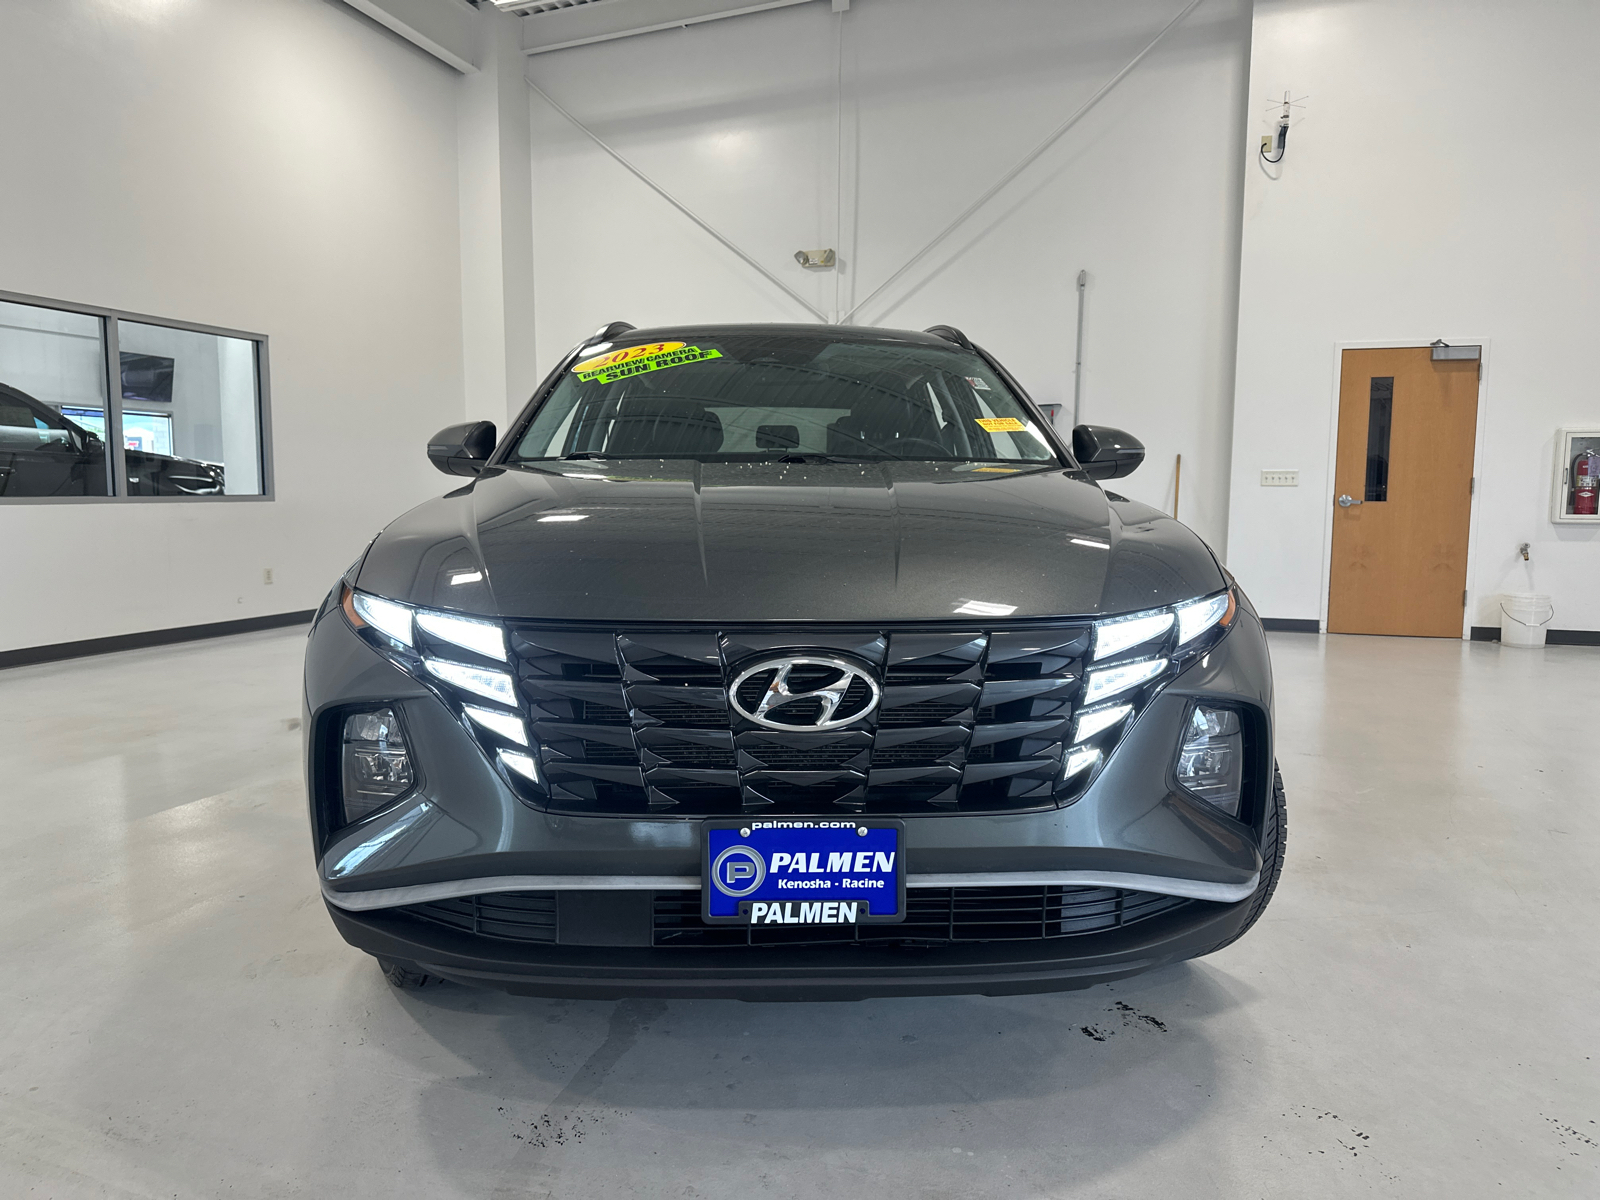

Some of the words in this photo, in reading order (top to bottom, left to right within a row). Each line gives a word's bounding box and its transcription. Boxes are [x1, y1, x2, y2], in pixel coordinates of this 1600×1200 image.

[583, 358, 645, 379] REARVIEW
[646, 348, 695, 361] CAMERA
[594, 344, 665, 368] 2023
[606, 363, 650, 380] SUN
[656, 352, 712, 368] ROOF
[752, 820, 856, 830] palmen.com
[769, 851, 895, 873] PALMEN
[778, 879, 831, 889] Kenosha
[842, 878, 885, 888] Racine
[750, 902, 858, 924] PALMEN
